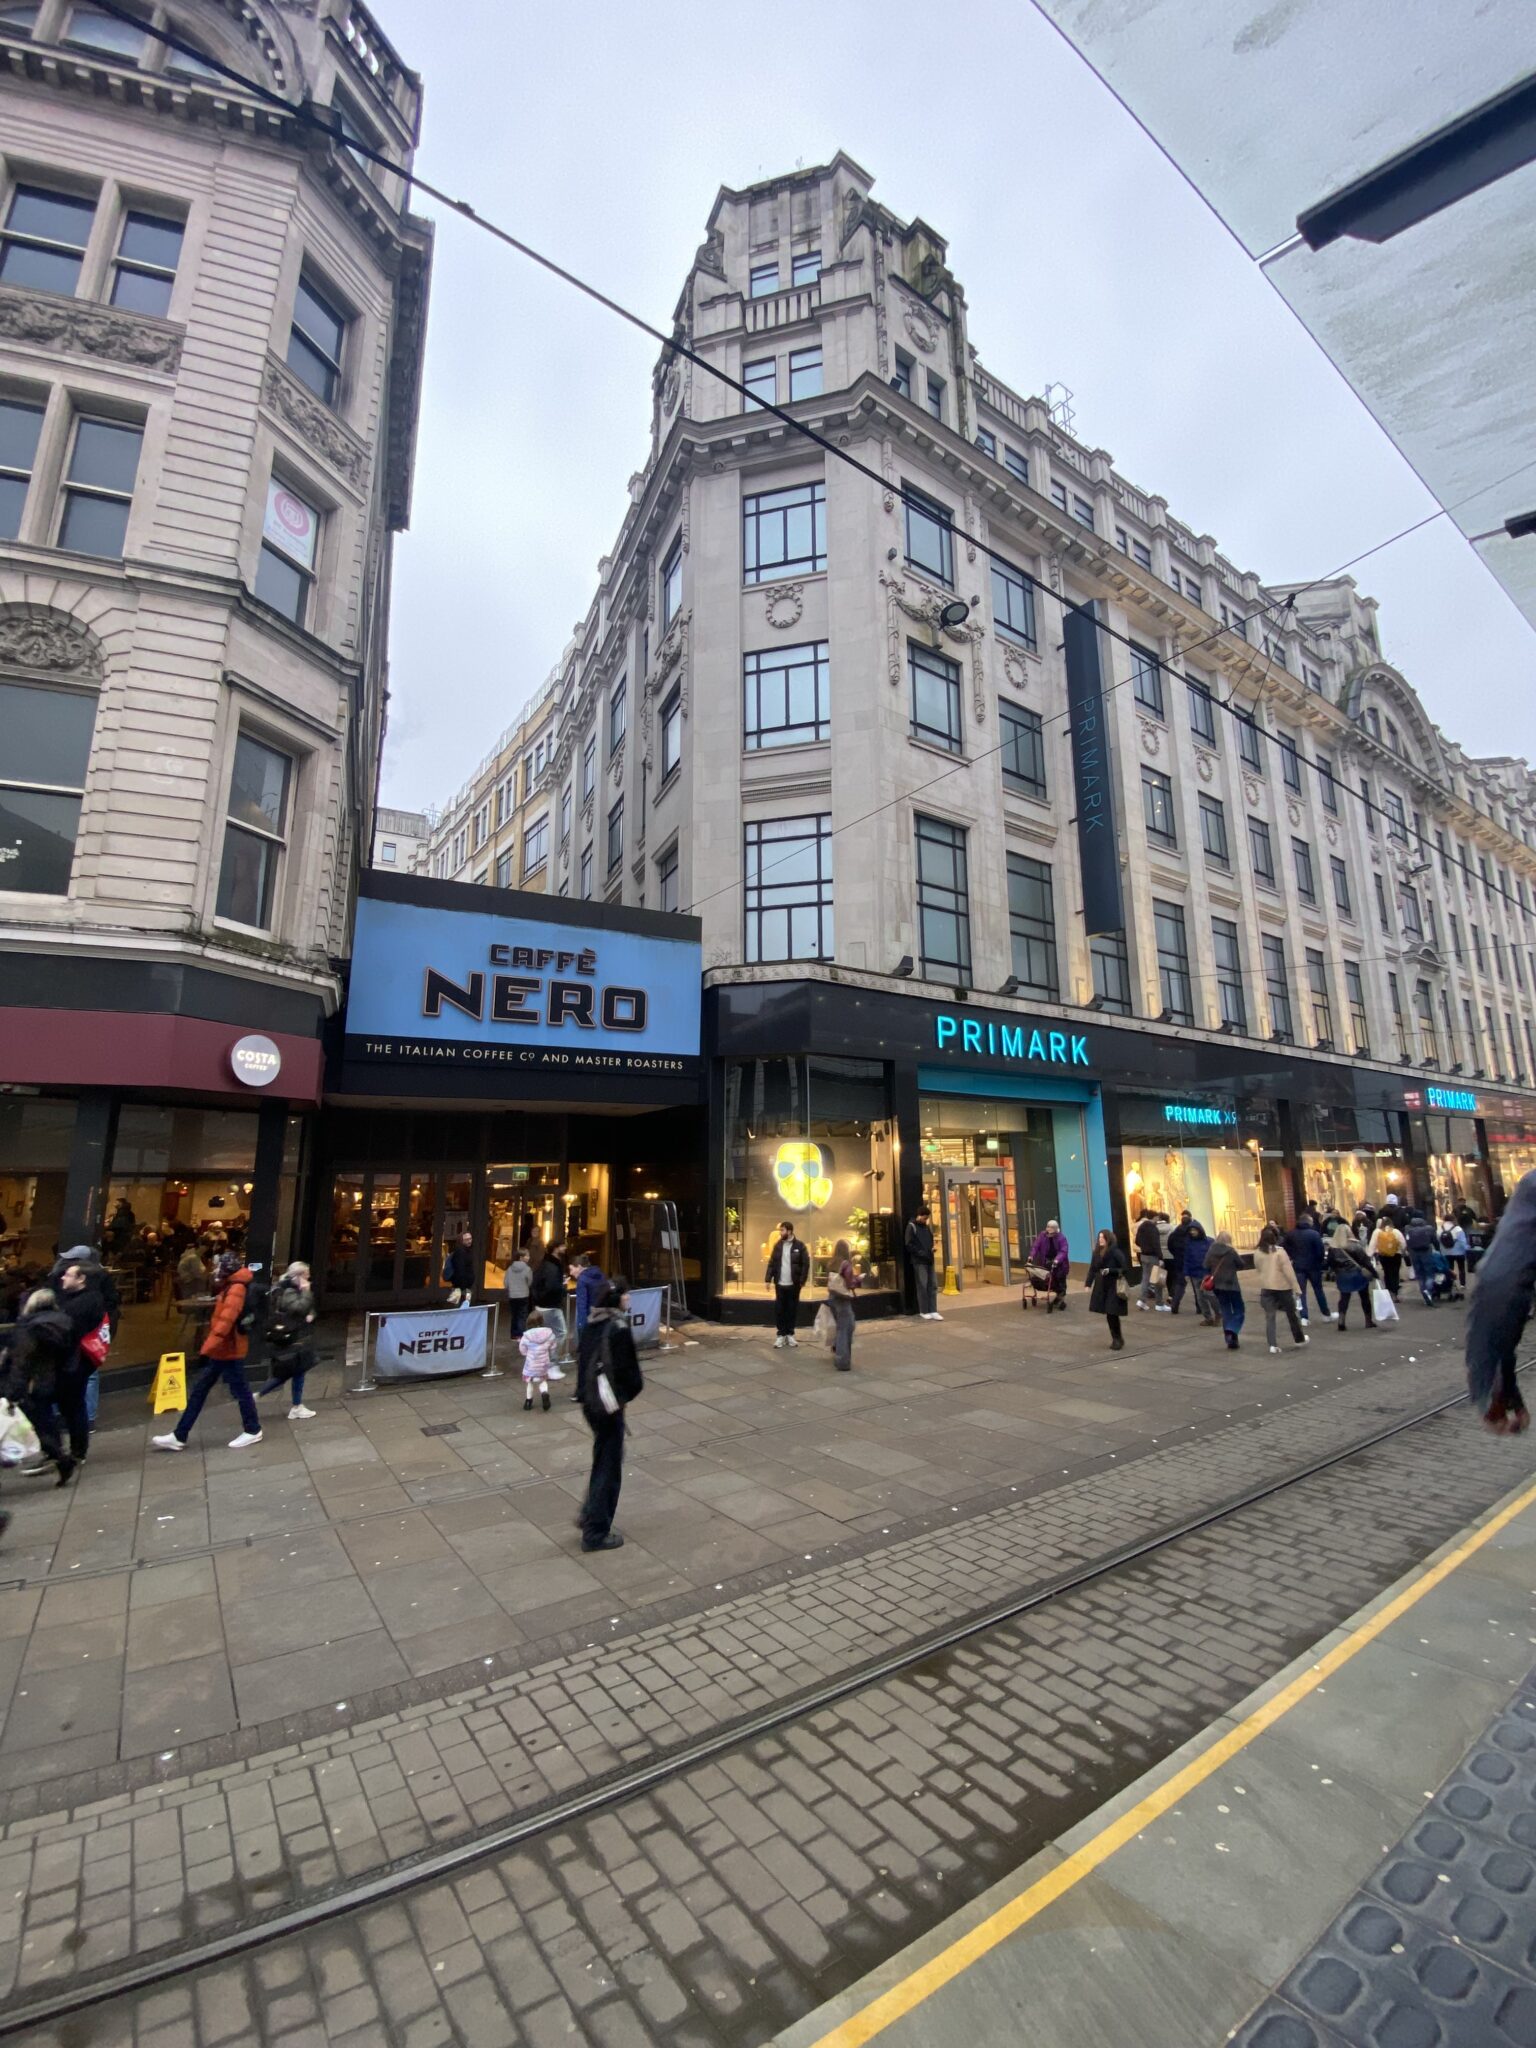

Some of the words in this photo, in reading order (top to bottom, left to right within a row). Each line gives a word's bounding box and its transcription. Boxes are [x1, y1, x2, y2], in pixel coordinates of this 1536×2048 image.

[1077, 697, 1104, 833] PRIMARK
[488, 944, 596, 975] CAFFÈ
[423, 966, 648, 1032] NERO
[937, 1015, 1089, 1066] PRIMARK
[237, 1050, 277, 1066] COSTA
[366, 1042, 392, 1054] THE
[399, 1044, 456, 1057] ITALIAN
[462, 1049, 513, 1061] COFFEE
[541, 1053, 569, 1064] AND
[575, 1055, 621, 1067] MASTER
[626, 1058, 683, 1070] ROASTERS
[1427, 1087, 1476, 1111] PRIMARK
[1165, 1105, 1221, 1125] PRIMARK
[398, 1336, 465, 1356] NERO
